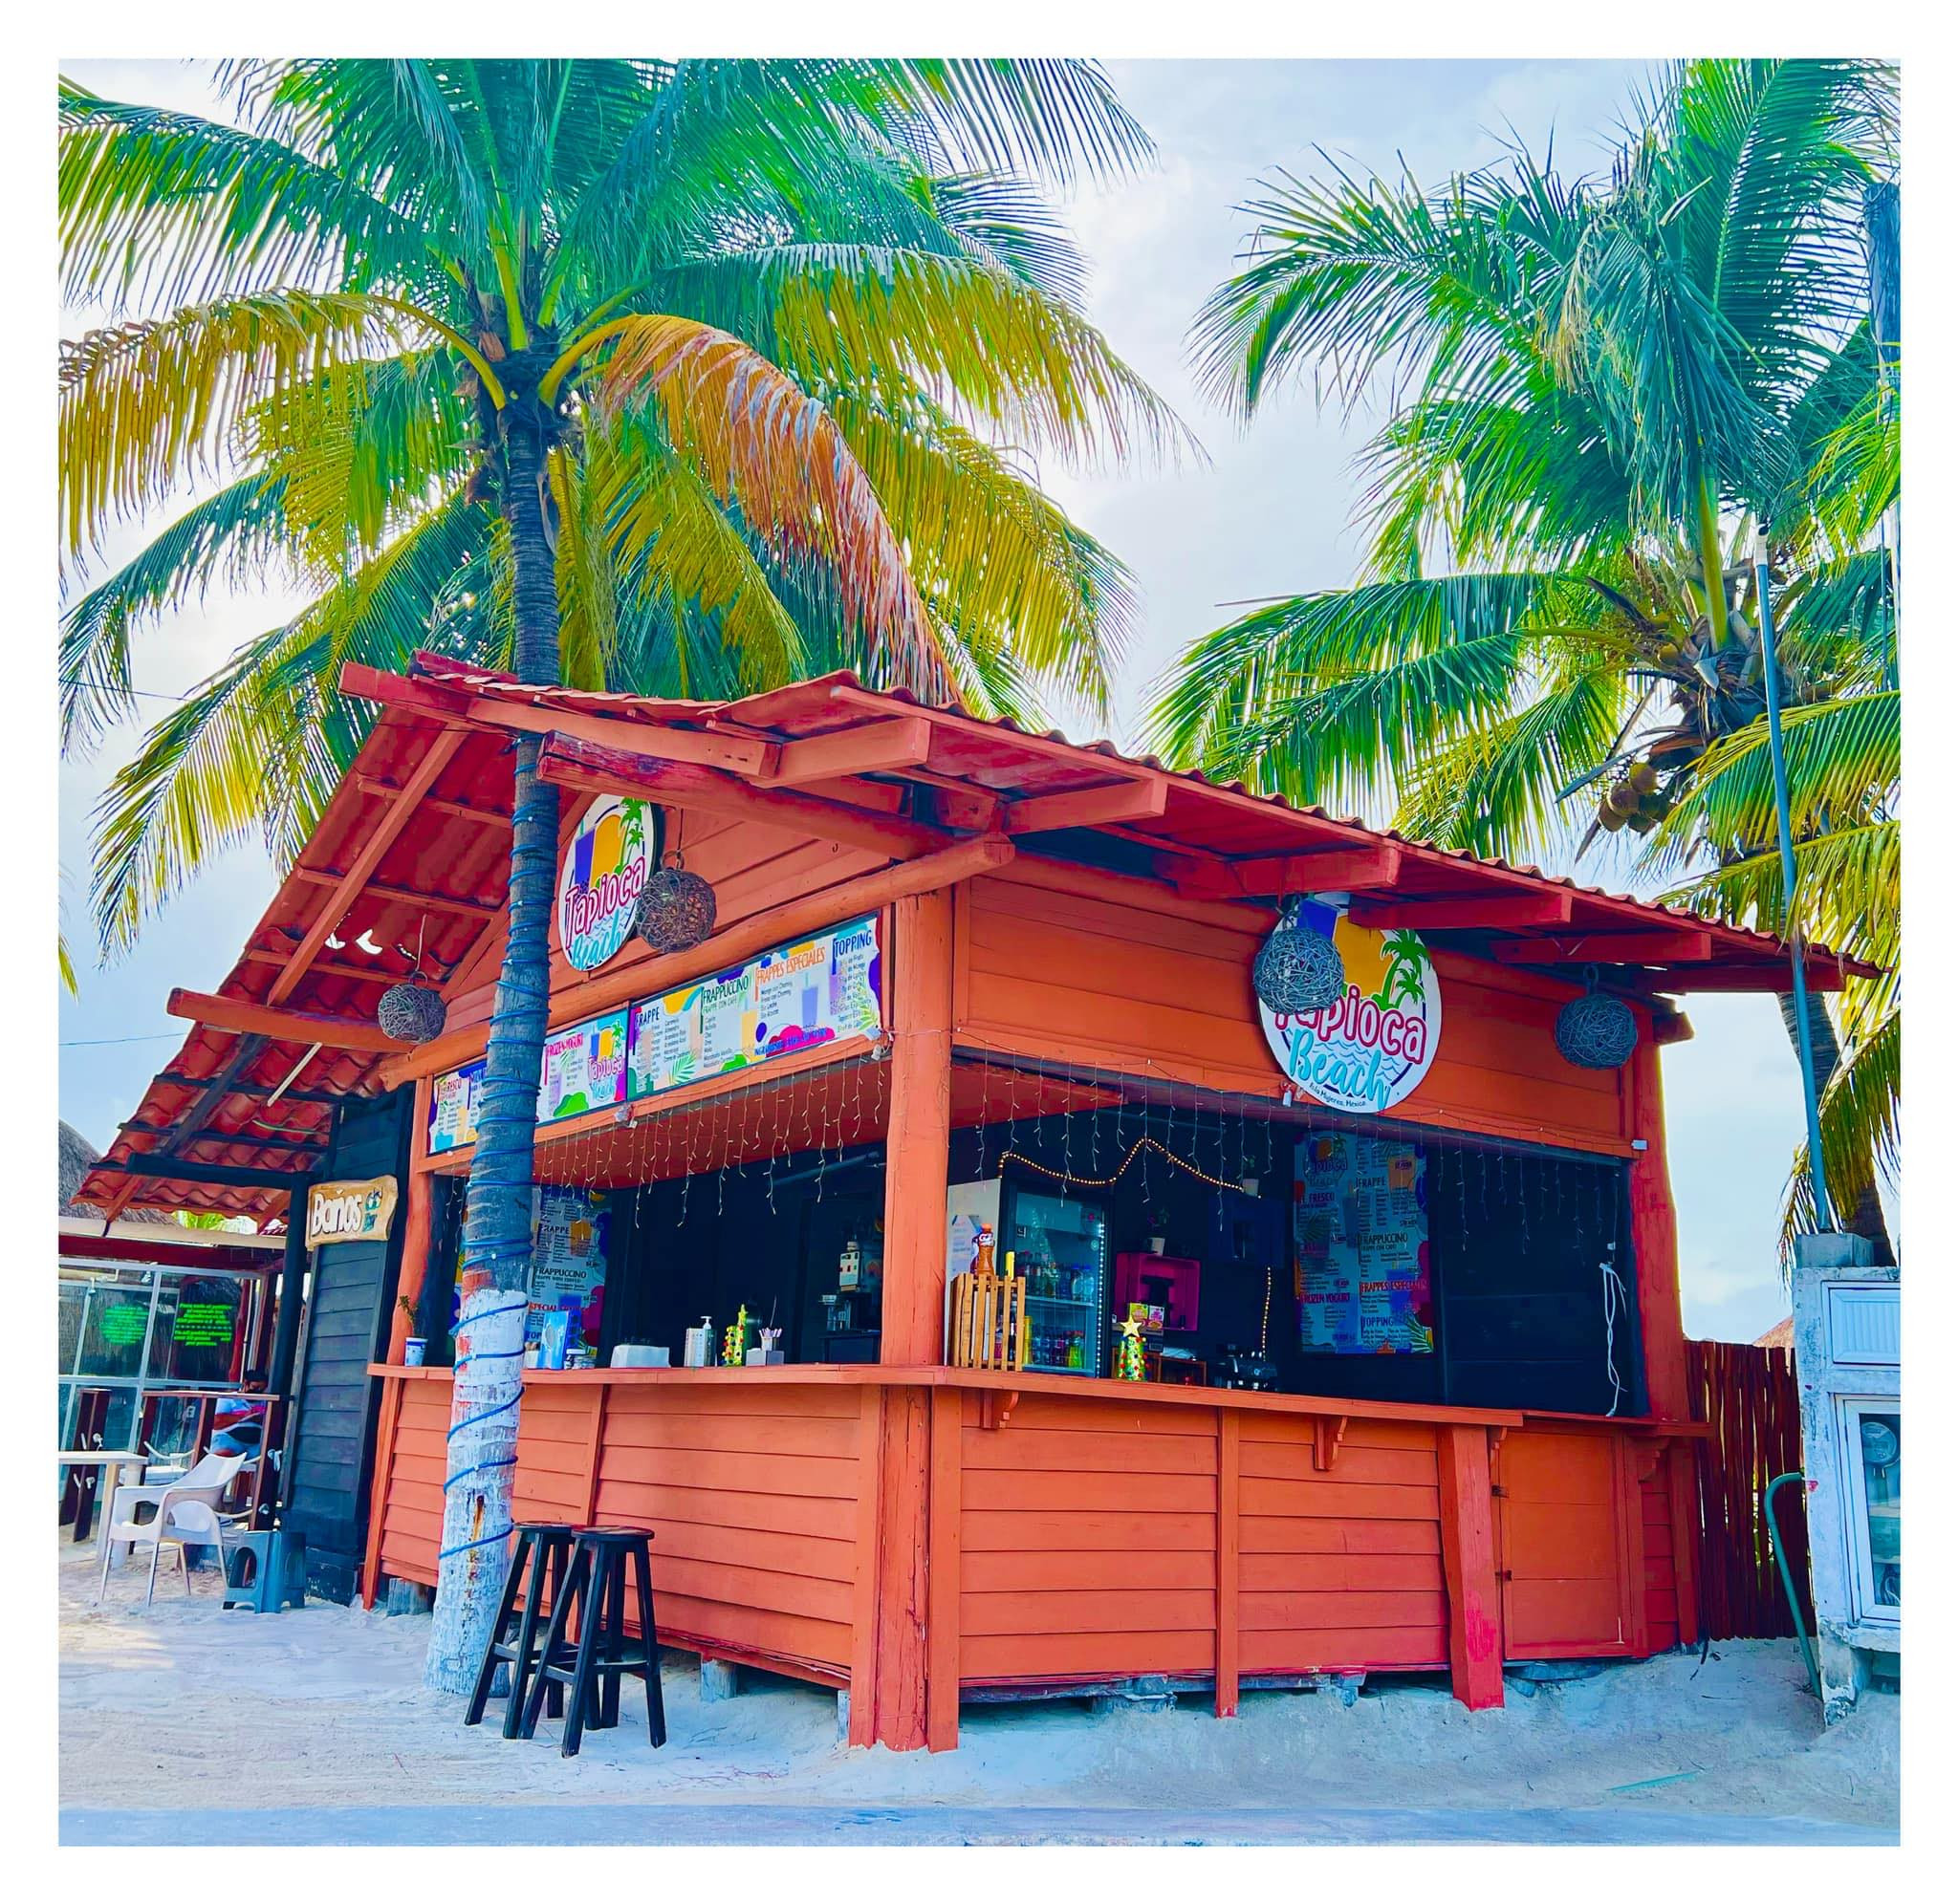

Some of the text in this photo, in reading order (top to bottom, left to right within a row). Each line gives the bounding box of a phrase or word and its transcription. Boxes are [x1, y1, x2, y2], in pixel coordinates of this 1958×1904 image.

[565, 855, 645, 949] Tapioca
[573, 909, 625, 970] Beach
[835, 929, 872, 958] TOPPING
[757, 946, 826, 984] FRAPPES ESPECIALES
[703, 975, 749, 1005] FRAPPUCCINO
[635, 1006, 660, 1028] FRAPPE
[1274, 984, 1426, 1065] pioca
[588, 1055, 623, 1083] Tapioca
[1290, 1028, 1391, 1110] Beach
